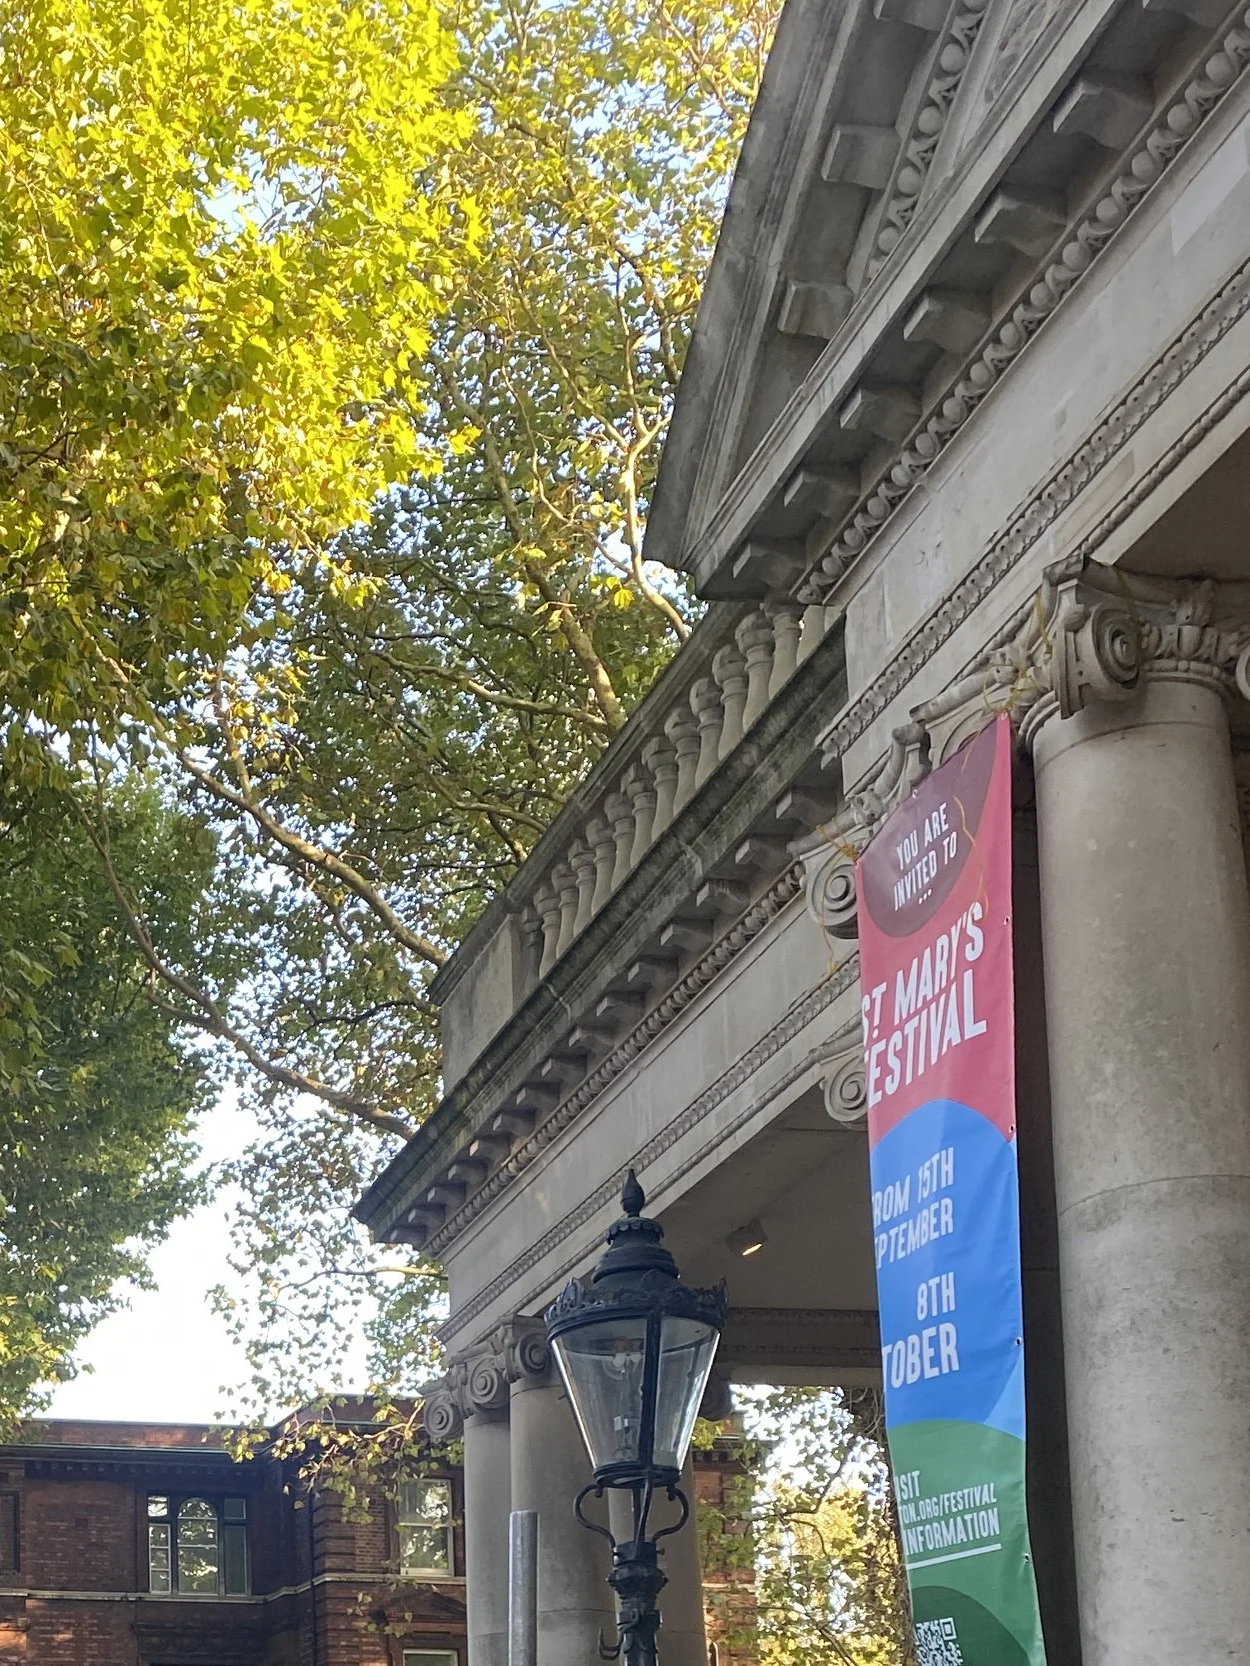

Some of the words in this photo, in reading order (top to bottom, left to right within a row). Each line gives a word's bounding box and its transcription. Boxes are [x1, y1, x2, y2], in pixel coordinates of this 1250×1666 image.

[894, 850, 937, 911] INVITED
[942, 831, 957, 865] TO
[896, 829, 919, 871] YOU
[924, 802, 949, 848] ARE
[894, 901, 984, 1026] MARY'S
[864, 969, 987, 1109] ESTIVAL
[872, 1174, 911, 1229] ROM
[917, 1147, 954, 1204] 15TH
[874, 1197, 954, 1270] PTEMBER
[917, 1271, 956, 1321] 8TH
[881, 1322, 960, 1394] TOBER
[894, 1470, 920, 1502] ISIT
[903, 1507, 1000, 1556] INFORMATION
